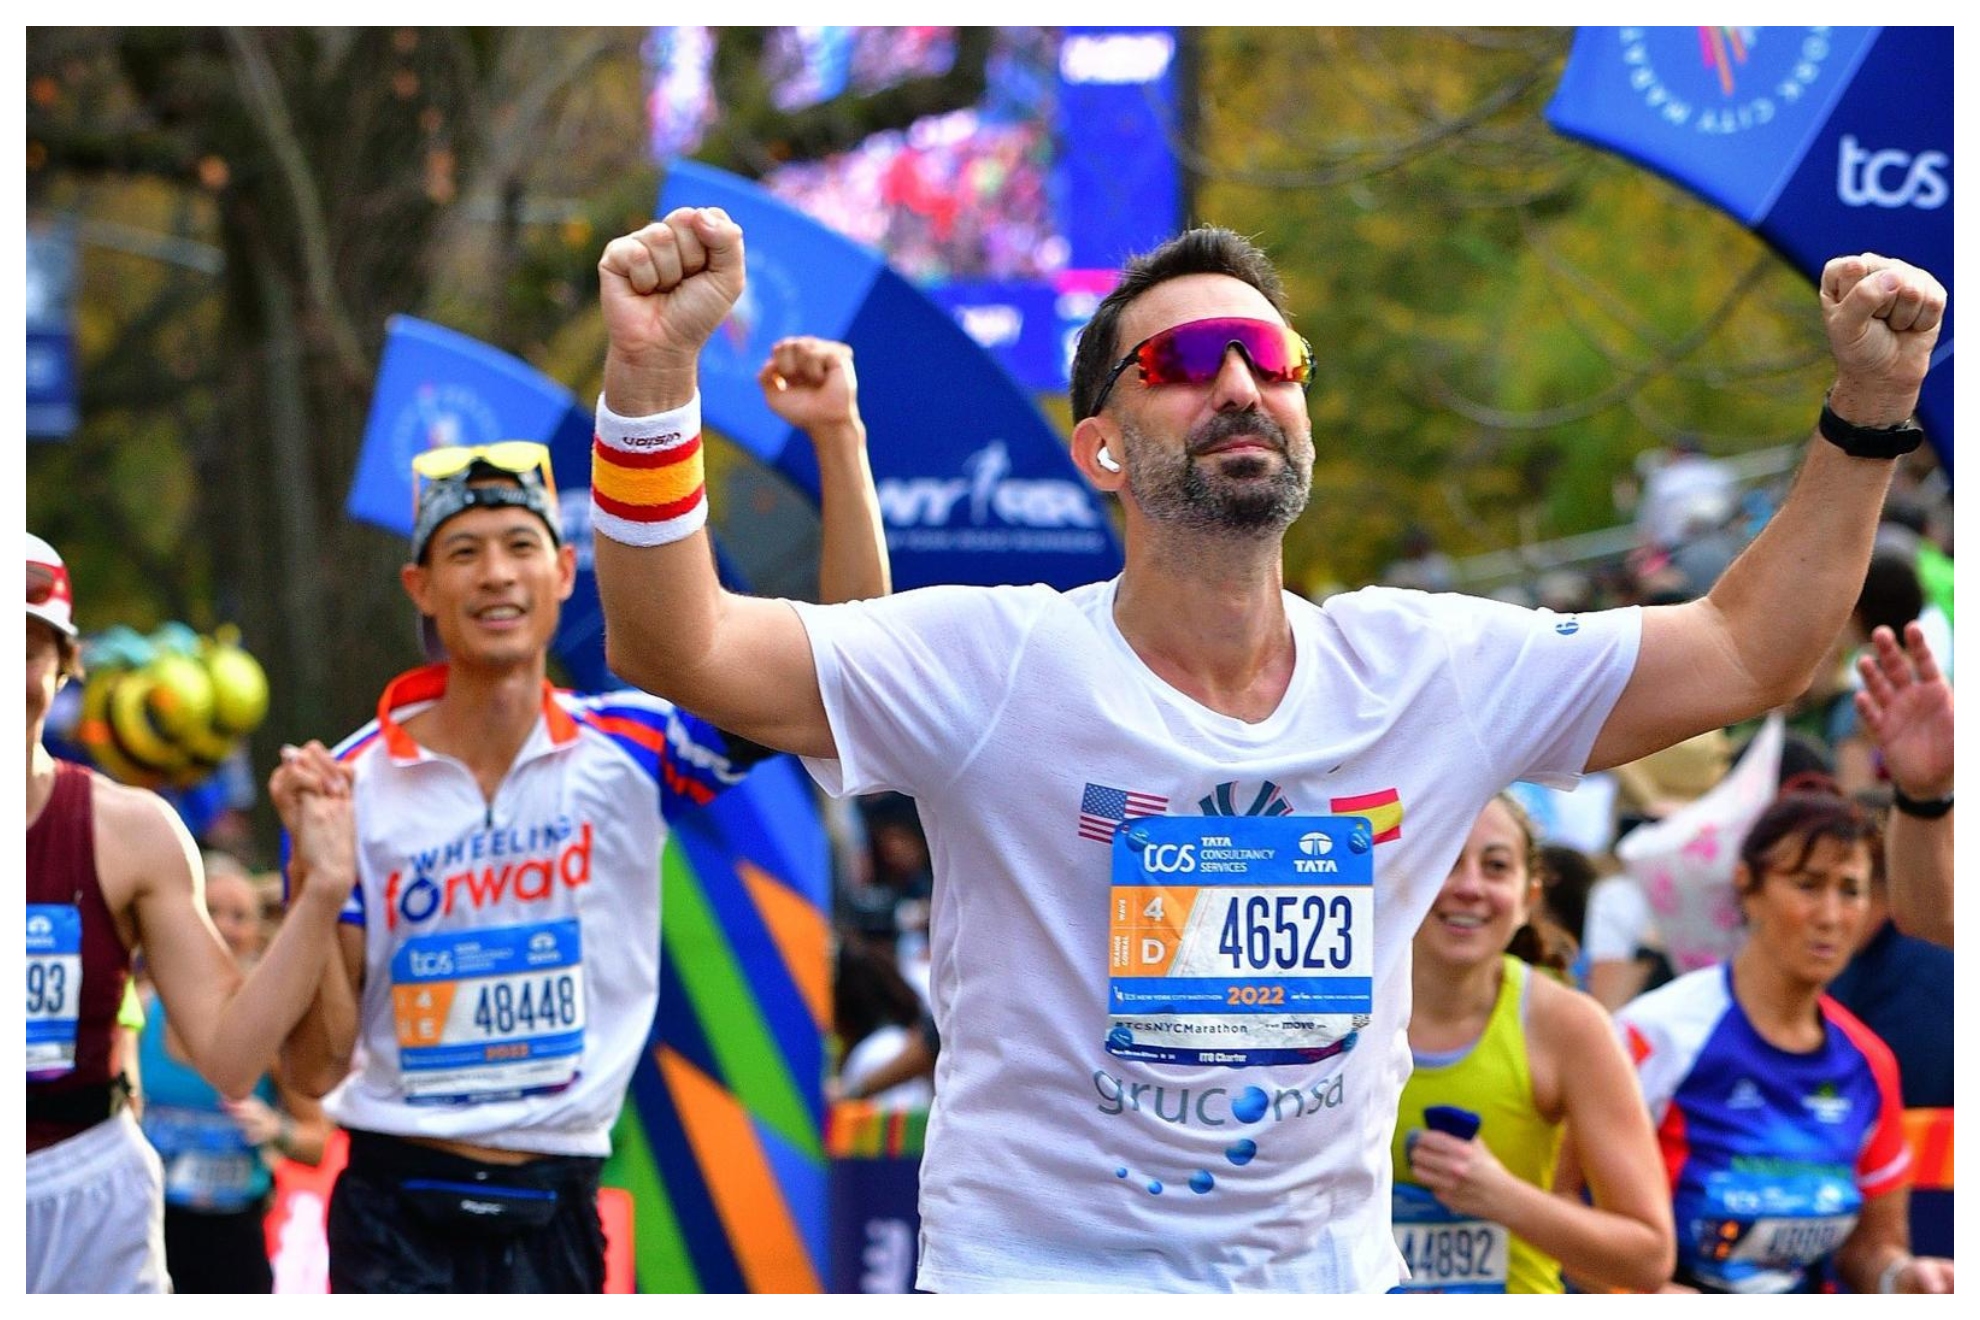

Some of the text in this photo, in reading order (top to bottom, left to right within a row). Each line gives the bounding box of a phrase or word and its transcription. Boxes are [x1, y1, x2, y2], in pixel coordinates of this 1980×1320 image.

[1836, 133, 1949, 209] tcs
[1200, 836, 1232, 847] TATA
[1293, 859, 1338, 873] TATA
[1200, 849, 1275, 860] CONSULTANCY
[1200, 862, 1248, 873] SERVICES
[1143, 896, 1164, 922] 4
[1219, 895, 1352, 970] 46523
[1141, 938, 1165, 964] D
[475, 975, 576, 1036] 48448
[1227, 986, 1285, 1005] 2022
[1402, 1228, 1495, 1278] 44892
